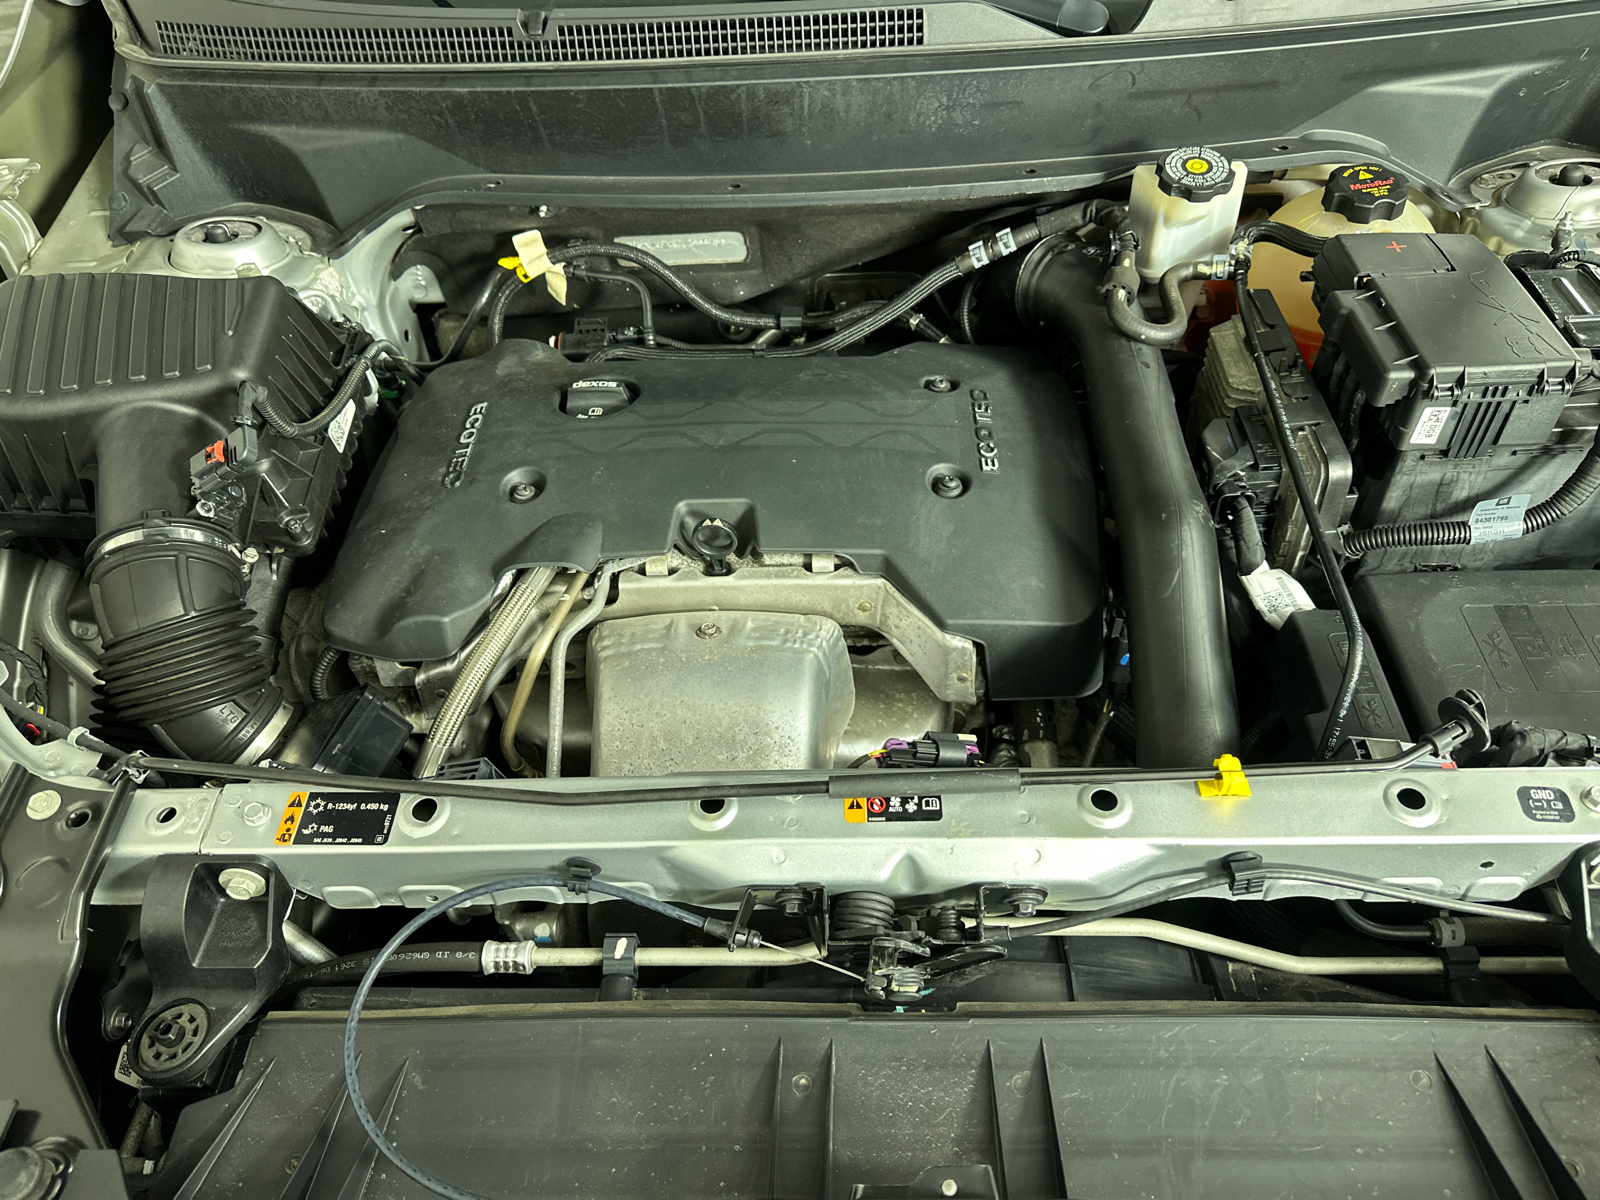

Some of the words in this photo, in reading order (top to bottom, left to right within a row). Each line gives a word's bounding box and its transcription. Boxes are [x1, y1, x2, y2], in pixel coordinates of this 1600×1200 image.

[572, 380, 618, 389] dexos
[969, 388, 1000, 474] ECOTEC
[444, 401, 489, 489] ECOTEC
[219, 705, 239, 724] LTG
[1530, 789, 1555, 800] GND
[326, 802, 358, 811] R-1234yf
[360, 802, 379, 810] 0.450
[379, 802, 389, 811] kg
[319, 825, 334, 833] PAG
[436, 951, 450, 959] ID
[456, 951, 476, 959] 3/8
